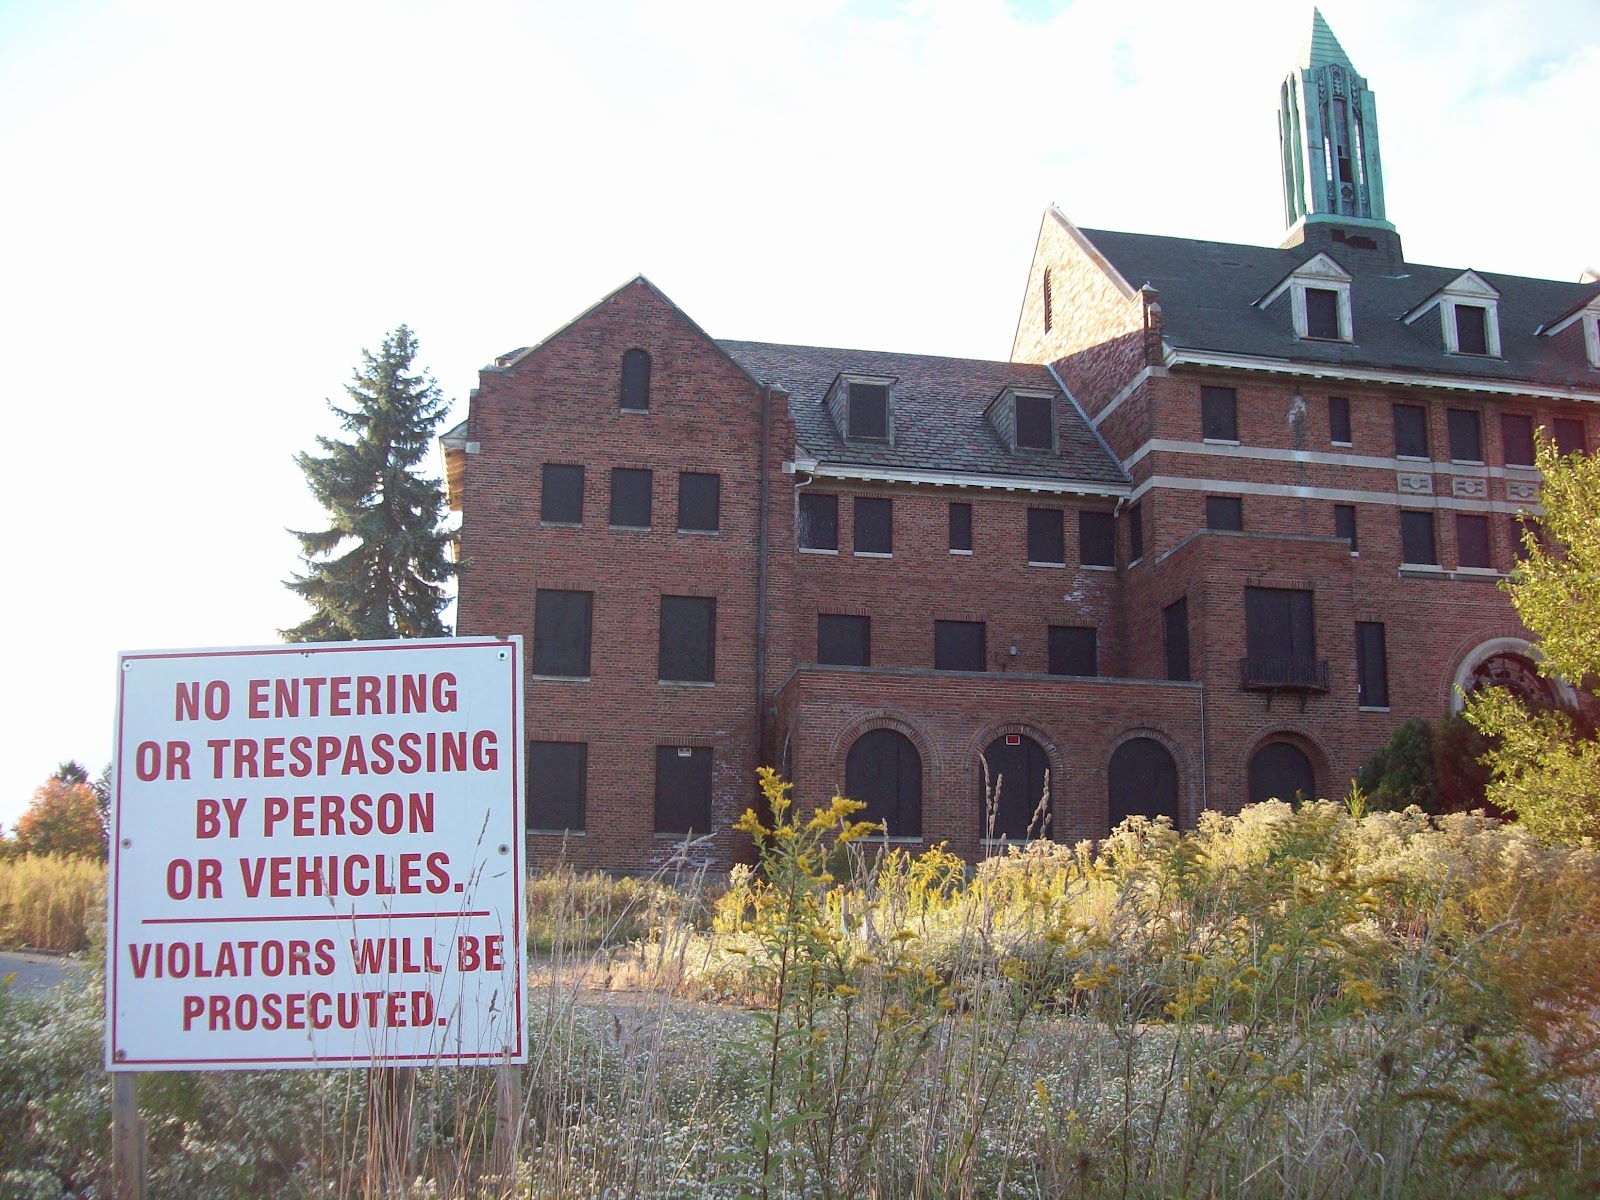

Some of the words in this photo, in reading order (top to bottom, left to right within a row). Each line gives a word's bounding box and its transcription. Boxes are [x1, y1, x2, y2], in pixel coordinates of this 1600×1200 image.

[175, 681, 230, 721] NO
[248, 672, 458, 719] ENTERING
[136, 740, 191, 781] OR
[207, 730, 499, 779] TRESPASSING
[196, 798, 248, 839] BY
[263, 792, 435, 837] PERSON
[166, 858, 223, 900] OR
[239, 852, 464, 898] VEHICLES.
[129, 939, 336, 979] VIOLATORS
[350, 936, 442, 975] WILL
[457, 935, 505, 972] BE
[183, 991, 447, 1031] PROSECUTED.
